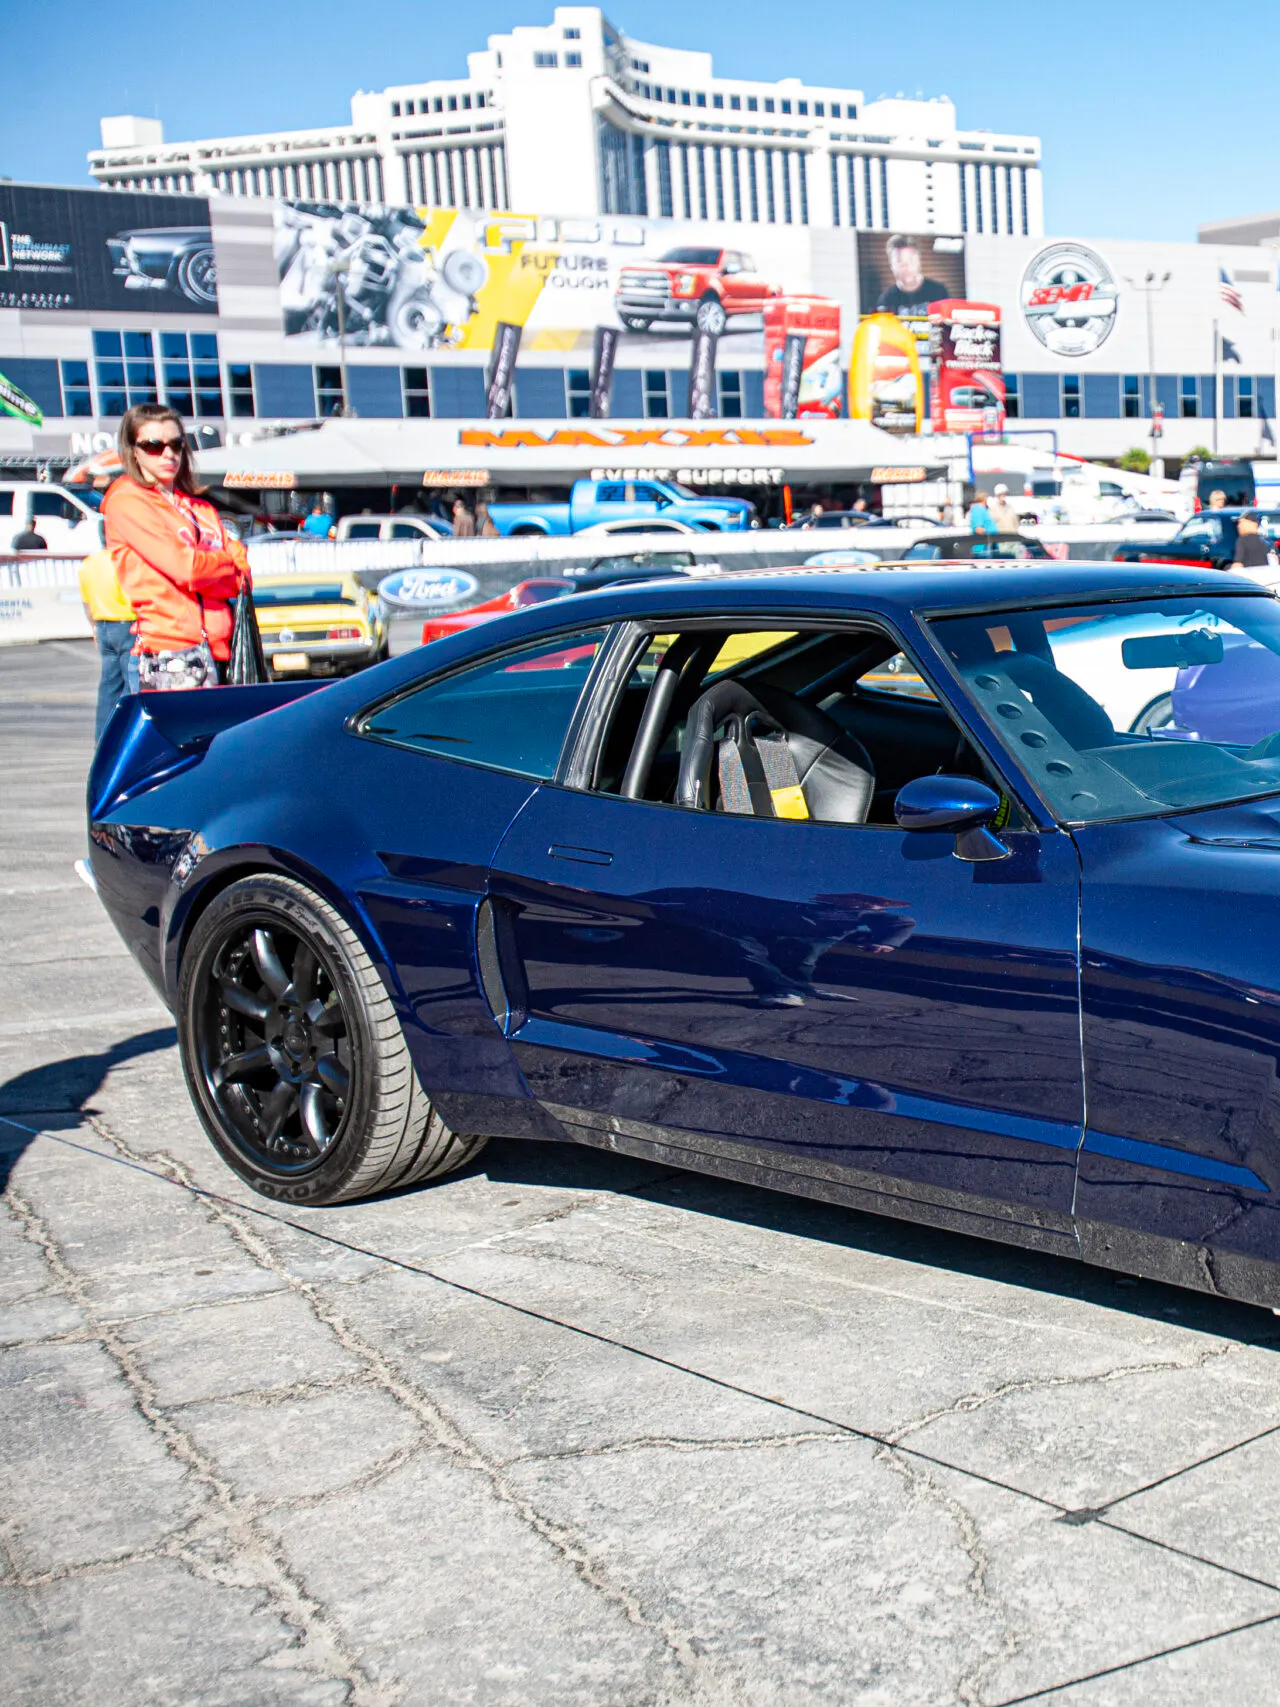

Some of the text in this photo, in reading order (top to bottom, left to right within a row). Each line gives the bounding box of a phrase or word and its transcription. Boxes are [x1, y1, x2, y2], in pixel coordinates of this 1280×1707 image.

[11, 233, 32, 245] THE
[12, 250, 64, 261] NETWORK
[520, 253, 609, 272] FUTURE
[540, 274, 610, 290] TOUGH
[1027, 282, 1096, 307] SEMA
[460, 427, 815, 448] MAXXIS
[224, 472, 297, 488] MAXXIS
[424, 471, 490, 486] MAXXIS
[590, 468, 785, 485] EVENT SUPPORT
[398, 573, 459, 600] Ford
